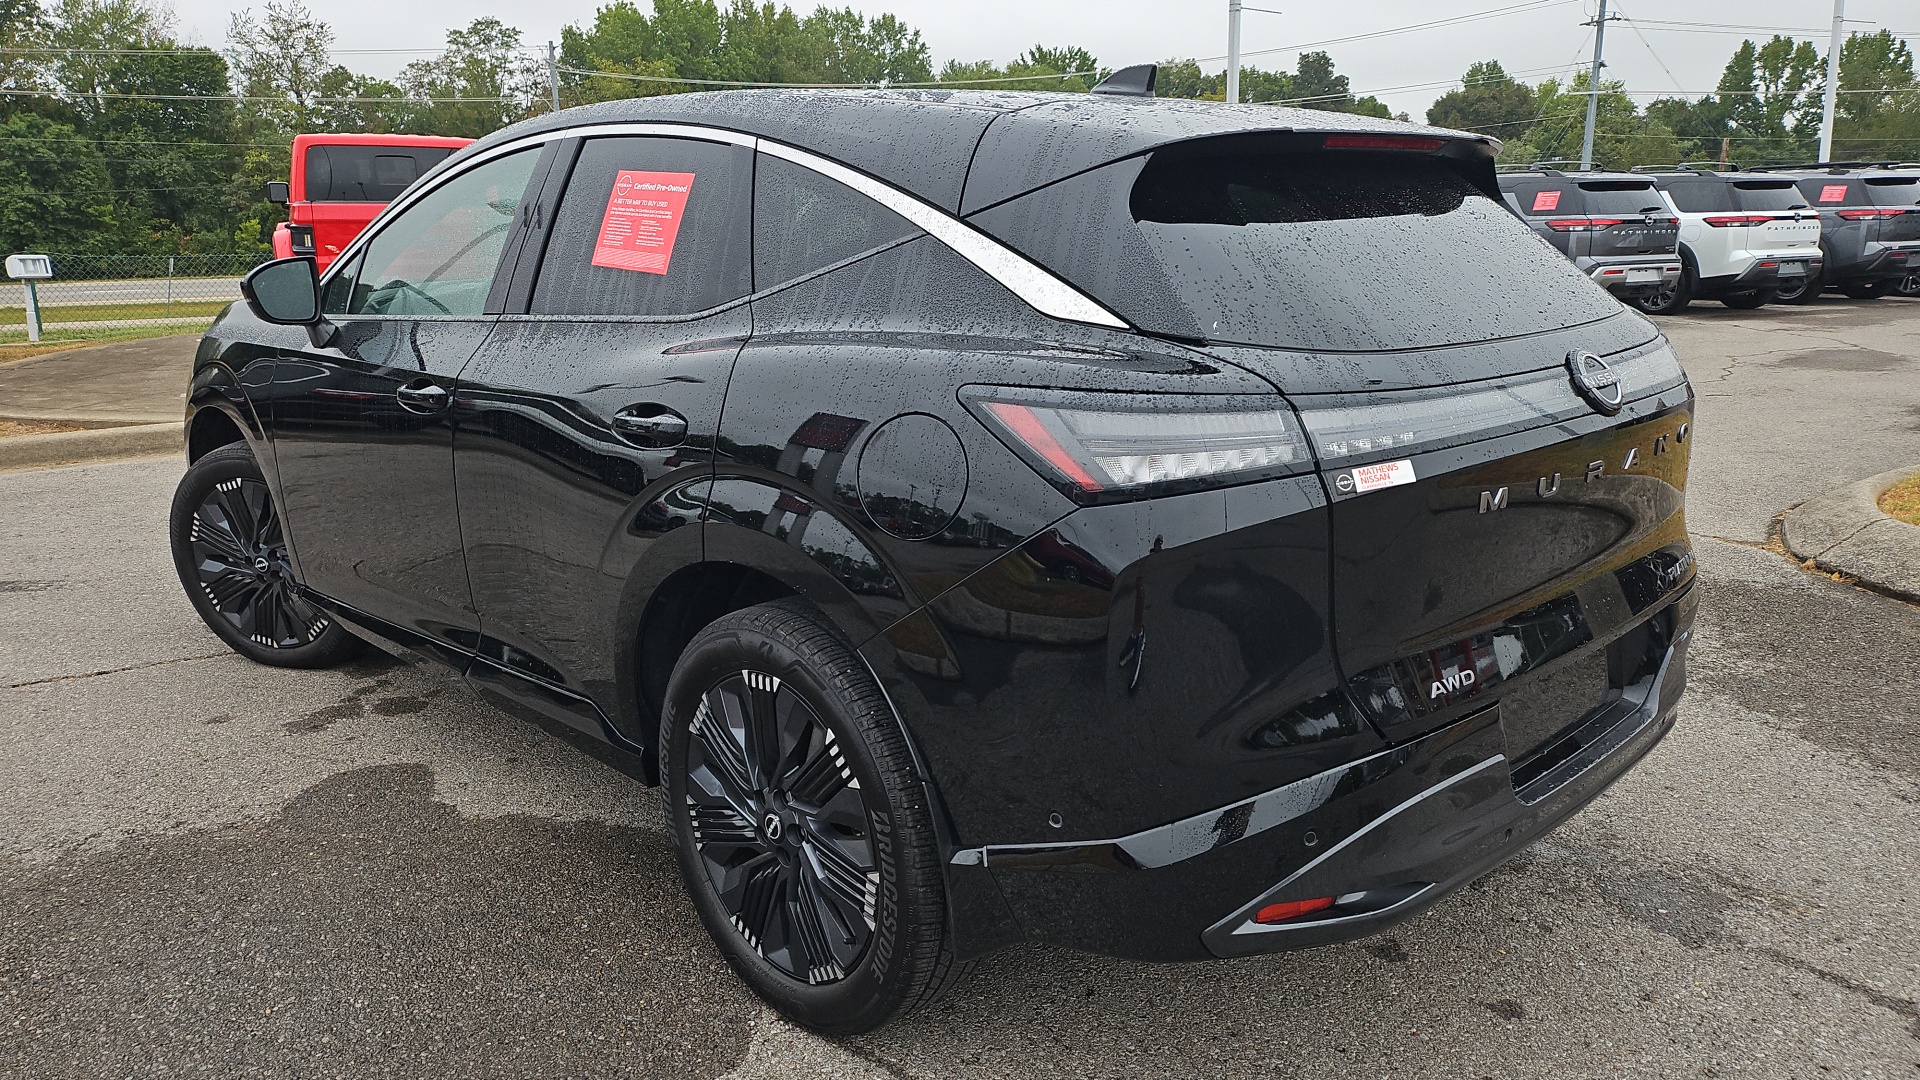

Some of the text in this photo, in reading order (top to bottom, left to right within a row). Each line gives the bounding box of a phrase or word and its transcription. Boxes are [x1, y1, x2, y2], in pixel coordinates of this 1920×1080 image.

[633, 182, 688, 193] Certified Pre-Owned
[1357, 463, 1399, 477] MATHEWS
[1360, 473, 1391, 485] NISSAN
[1478, 422, 1690, 514] MURANO
[1430, 669, 1476, 699] AWD
[659, 700, 680, 848] BRIDGESTONE
[869, 809, 900, 986] BRIDGESTONE
